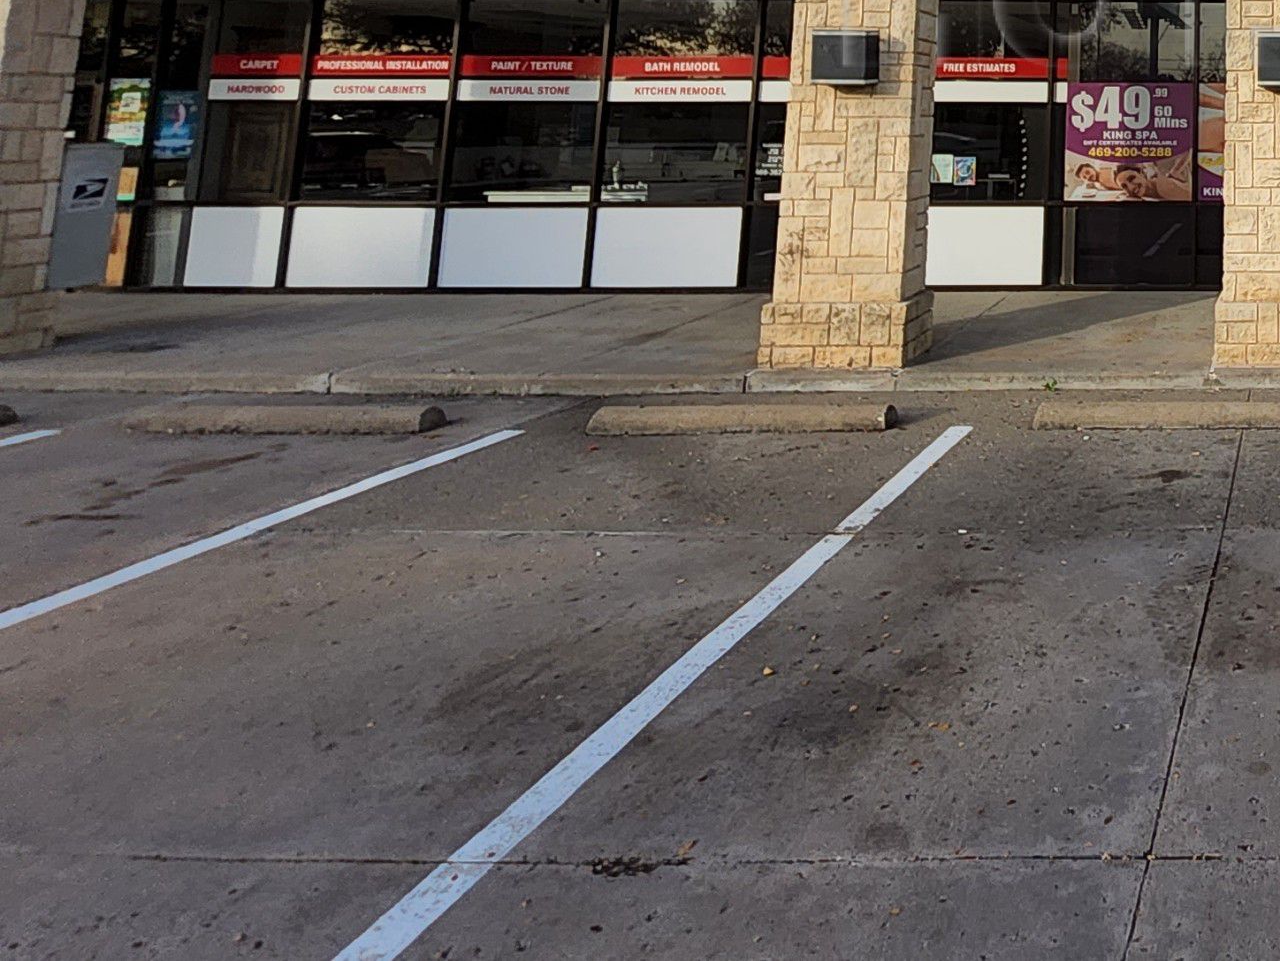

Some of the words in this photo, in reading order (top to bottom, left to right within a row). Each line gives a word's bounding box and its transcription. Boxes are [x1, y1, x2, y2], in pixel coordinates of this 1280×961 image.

[239, 58, 279, 71] CARPET
[317, 59, 384, 71] PROFESSIONAL
[386, 59, 449, 71] INSTALLATION
[491, 60, 521, 72] PAINT
[530, 60, 574, 72] TEXTURE
[644, 61, 671, 72] BATH
[673, 62, 721, 72] REMODEL
[942, 62, 966, 74] FREE
[966, 62, 1016, 74] ESTIMATES
[226, 84, 286, 95] HARDWOOD
[333, 84, 376, 95] CUSTOM
[378, 84, 427, 95] CABINETS
[489, 85, 535, 96] NATURAL
[537, 85, 571, 96] STONE
[634, 86, 678, 97] KITCHEN
[679, 86, 727, 97] REMODEL
[1153, 105, 1173, 117] 60
[1102, 130, 1132, 140] KING
[1135, 130, 1158, 140] SPA
[1088, 146, 1172, 157] 469-200-5288
[1202, 186, 1224, 197] KIN
